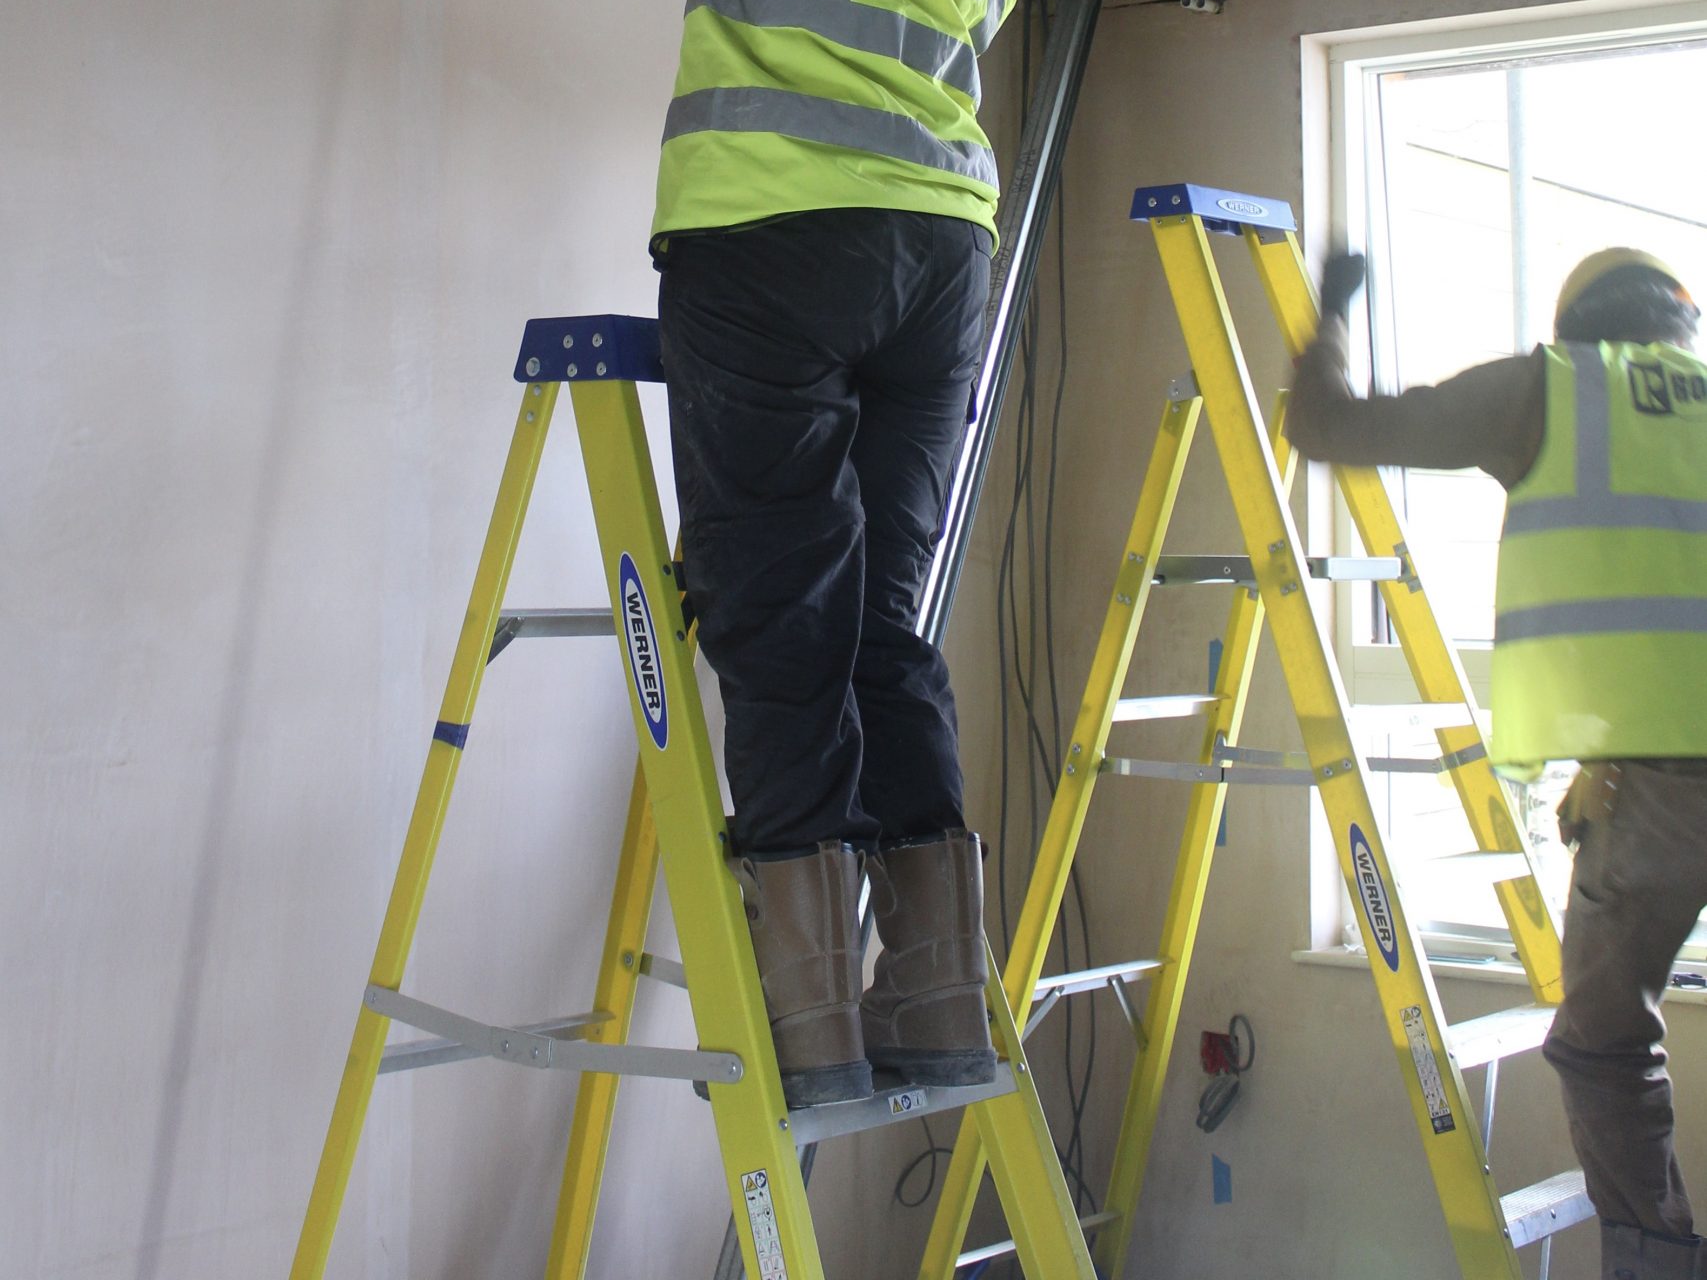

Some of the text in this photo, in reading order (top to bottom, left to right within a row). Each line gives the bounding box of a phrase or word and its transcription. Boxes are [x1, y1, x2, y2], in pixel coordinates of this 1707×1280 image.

[1226, 200, 1261, 215] WERNER
[627, 591, 660, 711] WERNER
[1357, 852, 1391, 944] WERNER
